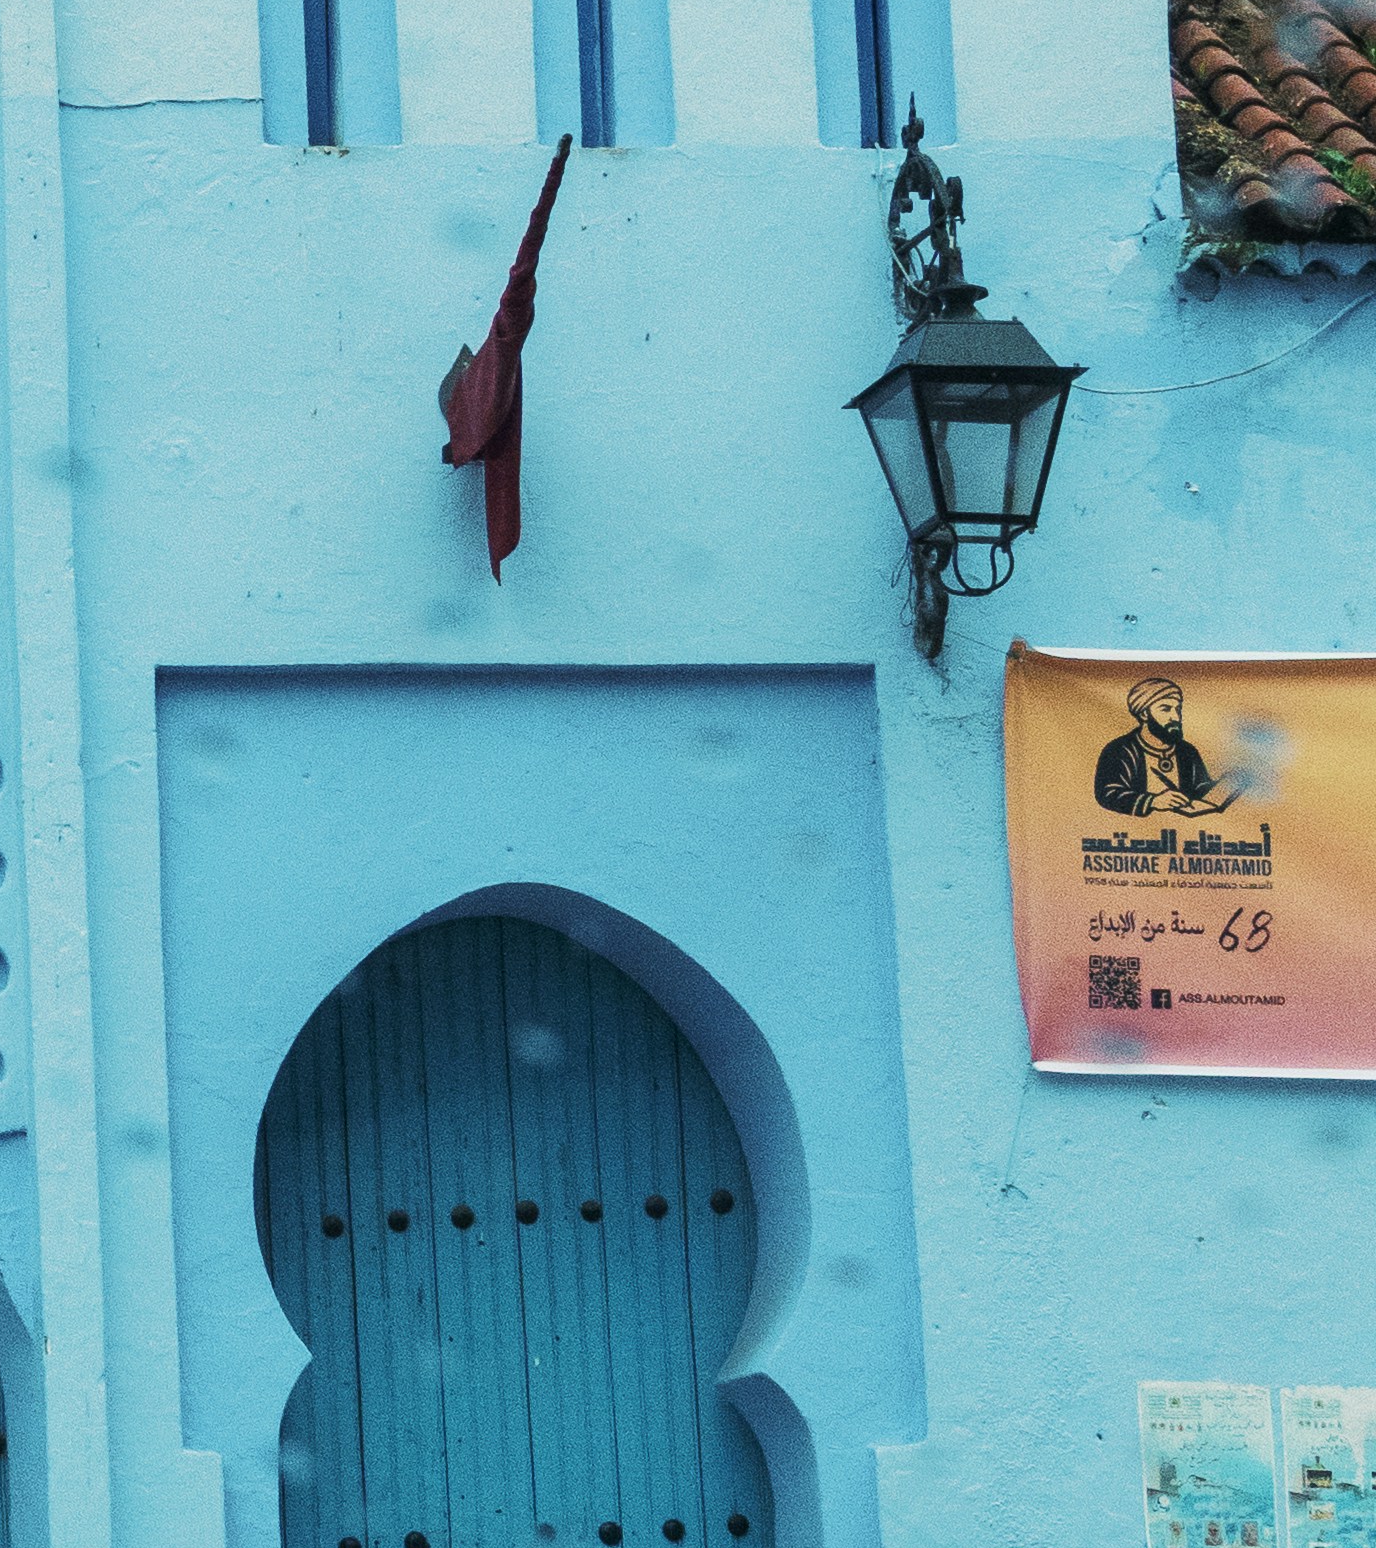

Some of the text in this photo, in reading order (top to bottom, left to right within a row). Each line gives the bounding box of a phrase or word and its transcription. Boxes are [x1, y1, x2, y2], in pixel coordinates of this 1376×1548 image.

[1083, 855, 1272, 876] ASSDIKAE ALMOATAMID
[1219, 907, 1273, 952] 68
